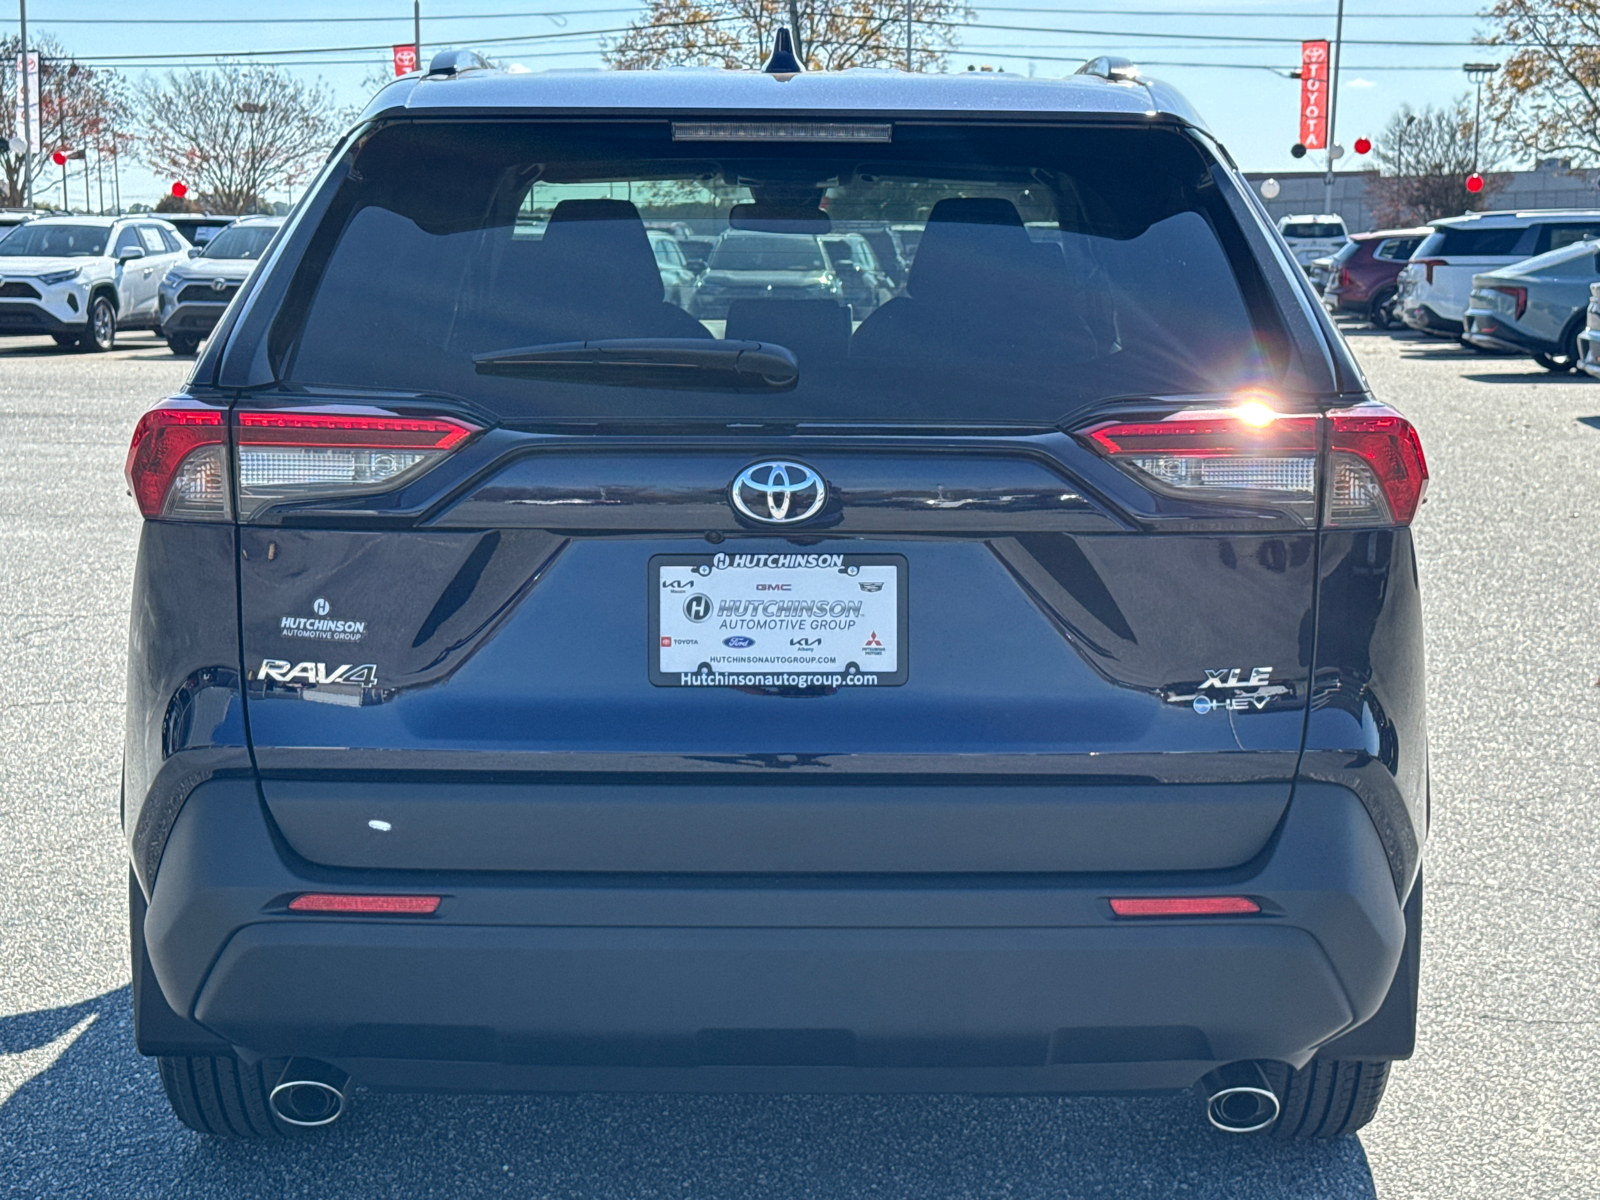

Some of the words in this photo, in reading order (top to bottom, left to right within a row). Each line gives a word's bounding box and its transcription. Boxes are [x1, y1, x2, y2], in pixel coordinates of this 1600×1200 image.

[1305, 64, 1319, 145] TOYOTA
[733, 554, 844, 568] HUTCHINSON
[756, 583, 792, 591] GMC
[717, 600, 862, 617] HUTCHINSON
[281, 617, 365, 633] HUTCHINSON
[719, 619, 806, 631] AUTOMOTIVE
[810, 619, 856, 631] GROUP
[282, 629, 331, 639] AUTOMOTIVE
[334, 632, 361, 640] GROUP
[729, 637, 750, 647] Ford
[710, 656, 836, 664] HUTCHINSONAUTOGROUP.COM
[257, 659, 378, 688] RAV4
[681, 672, 878, 687] Hutchinsonautogroup.com
[1198, 667, 1273, 688] XLE
[1212, 697, 1270, 710] HEV
